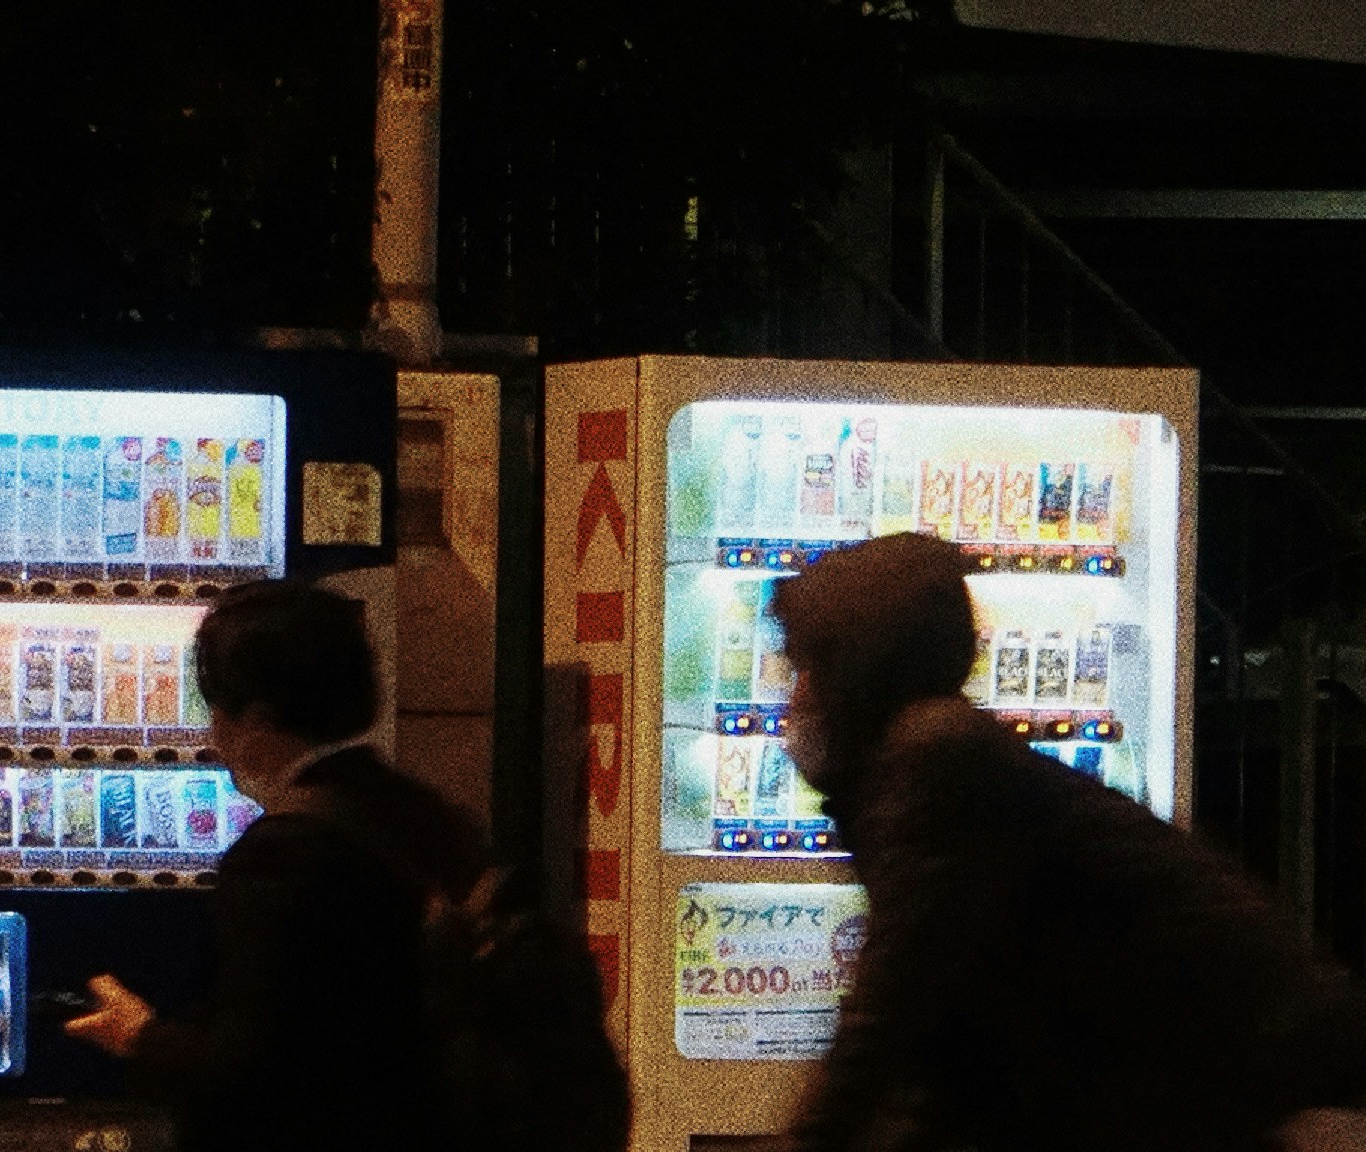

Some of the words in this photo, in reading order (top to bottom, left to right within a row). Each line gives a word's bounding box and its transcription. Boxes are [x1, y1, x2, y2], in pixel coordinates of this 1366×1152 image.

[716, 904, 825, 928] ファイアで
